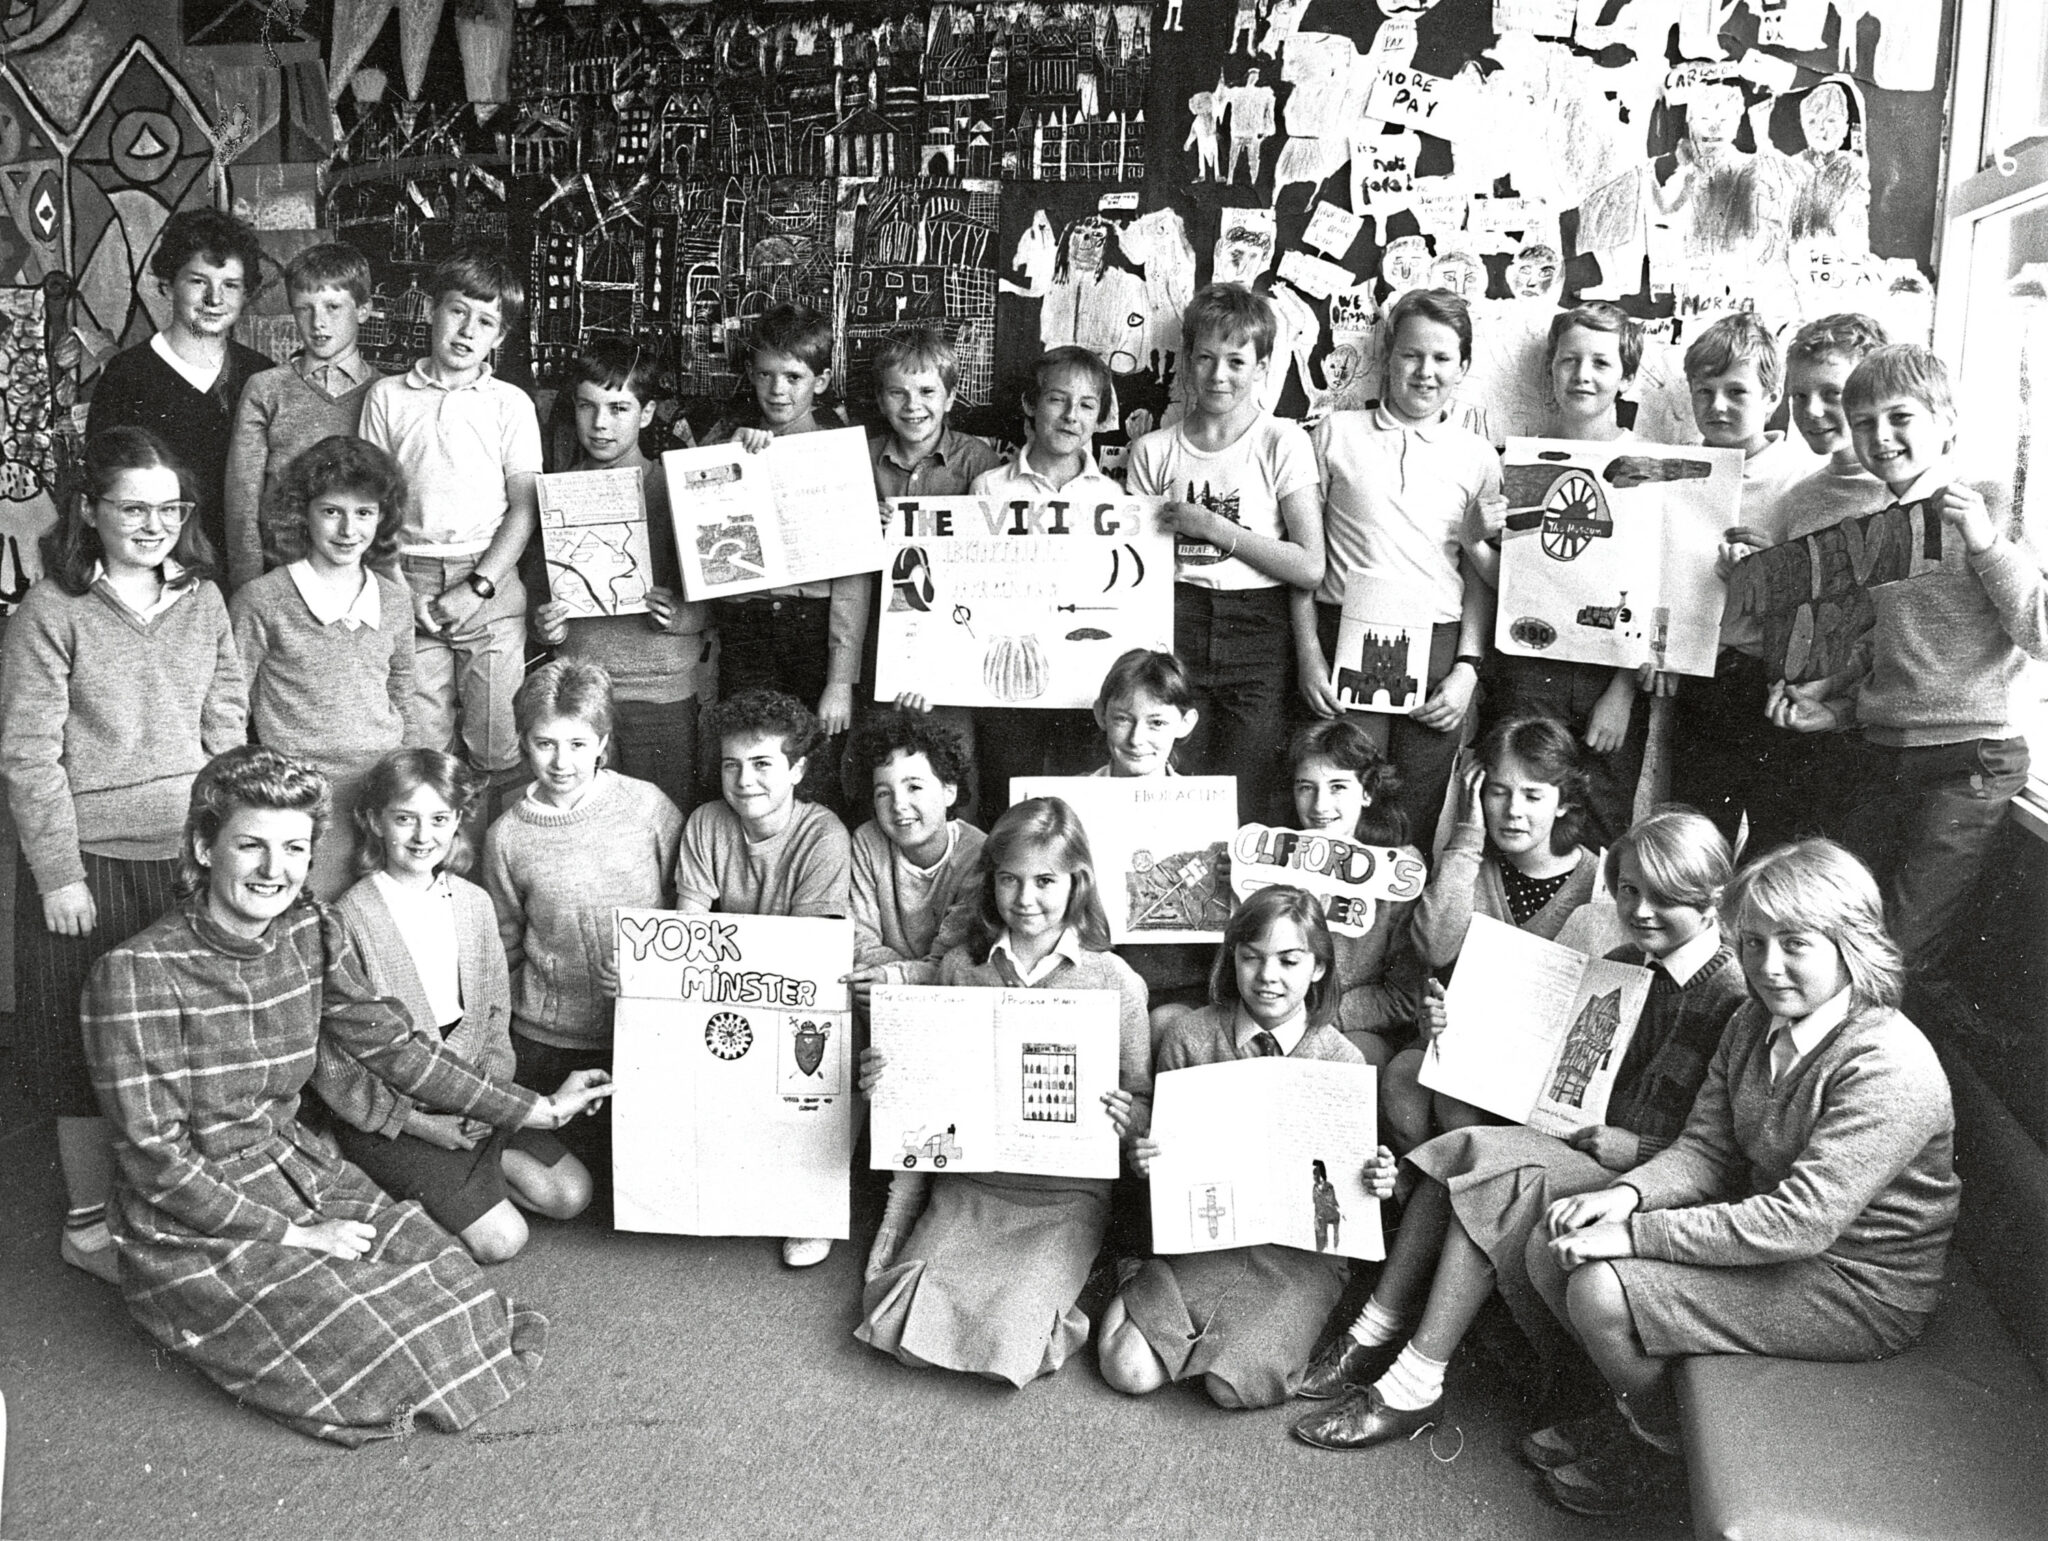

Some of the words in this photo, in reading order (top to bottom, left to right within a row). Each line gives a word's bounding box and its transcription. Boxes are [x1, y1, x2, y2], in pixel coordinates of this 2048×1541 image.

[1382, 69, 1439, 93] MORE
[1392, 88, 1439, 118] PAY
[1339, 294, 1361, 310] WE
[898, 502, 954, 537] THE
[978, 500, 1142, 536] VIKIGS
[620, 917, 741, 963] YORK
